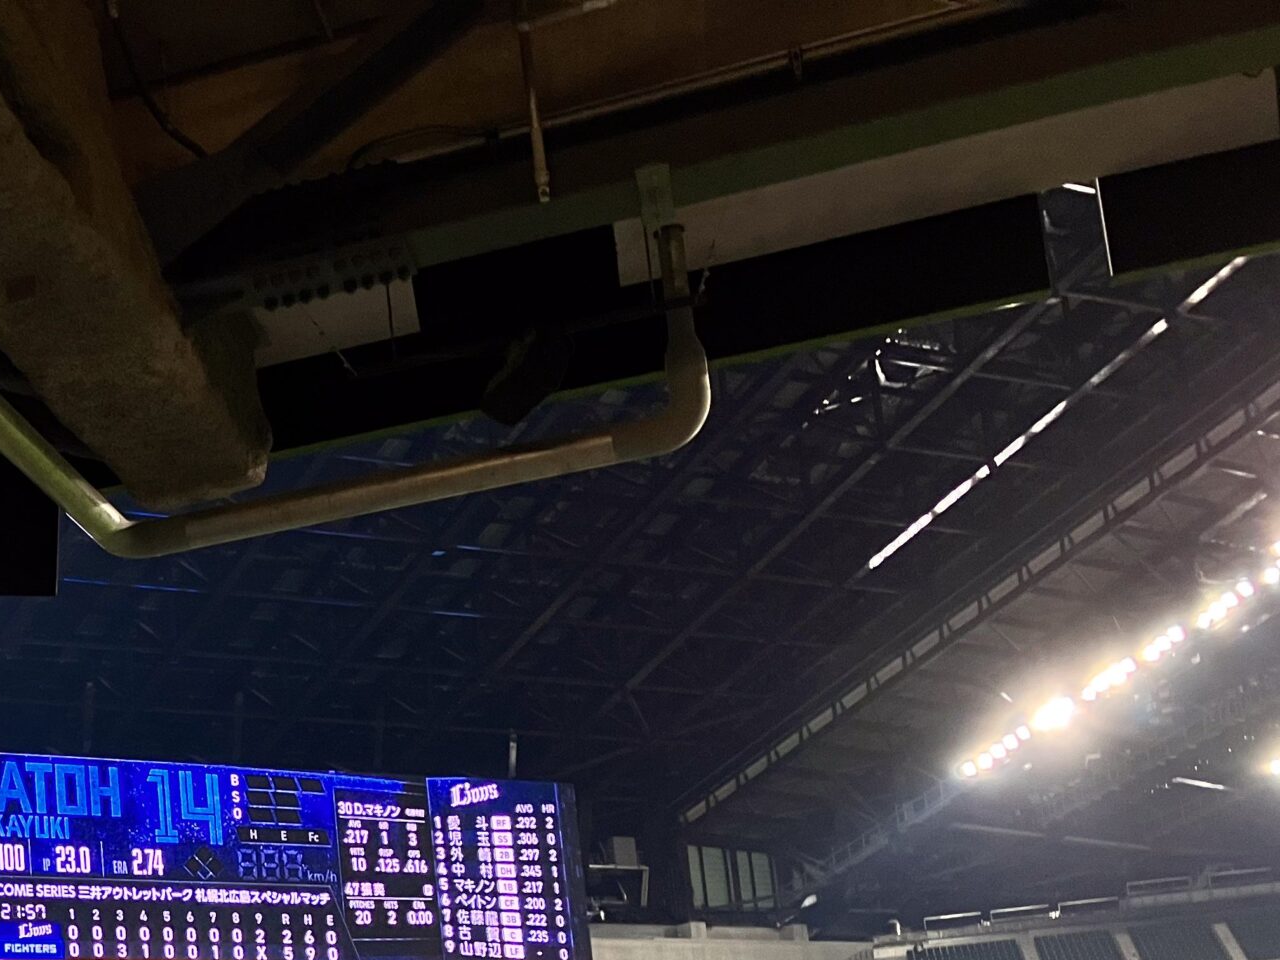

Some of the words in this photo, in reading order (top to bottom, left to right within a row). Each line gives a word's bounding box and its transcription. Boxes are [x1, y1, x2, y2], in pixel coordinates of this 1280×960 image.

[230, 774, 239, 786] B
[231, 790, 240, 803] S
[450, 781, 500, 807] Lions
[146, 768, 224, 845] 14
[515, 804, 533, 814] AVG
[542, 804, 555, 814] HR
[249, 829, 258, 840] H
[280, 830, 288, 841] E
[343, 829, 369, 844] .217
[42, 858, 51, 871] IP
[55, 846, 91, 874] 23.0
[112, 860, 128, 874] ERA
[131, 848, 165, 876] 2.74
[351, 857, 368, 872] 10
[307, 870, 338, 882] km/h
[36, 884, 76, 898] SERIES
[68, 908, 75, 920] 1
[92, 908, 101, 921] 2
[116, 909, 124, 921] 3
[139, 909, 148, 922] 4
[162, 910, 170, 922] 5
[186, 911, 194, 923] 6
[209, 911, 217, 924] 7
[232, 911, 240, 924] 8
[254, 912, 263, 925] 9
[281, 913, 290, 925] R
[303, 913, 313, 925] H
[326, 914, 334, 926] E
[355, 910, 372, 925] 20
[387, 910, 397, 925] 2
[406, 910, 433, 925] 0.00
[18, 922, 53, 939] Lions
[281, 929, 293, 944] 2
[304, 929, 315, 944] 6
[325, 930, 337, 945] 0
[4, 943, 57, 954] FIGHTERS
[283, 946, 294, 960] 5
[305, 947, 316, 960] 9
